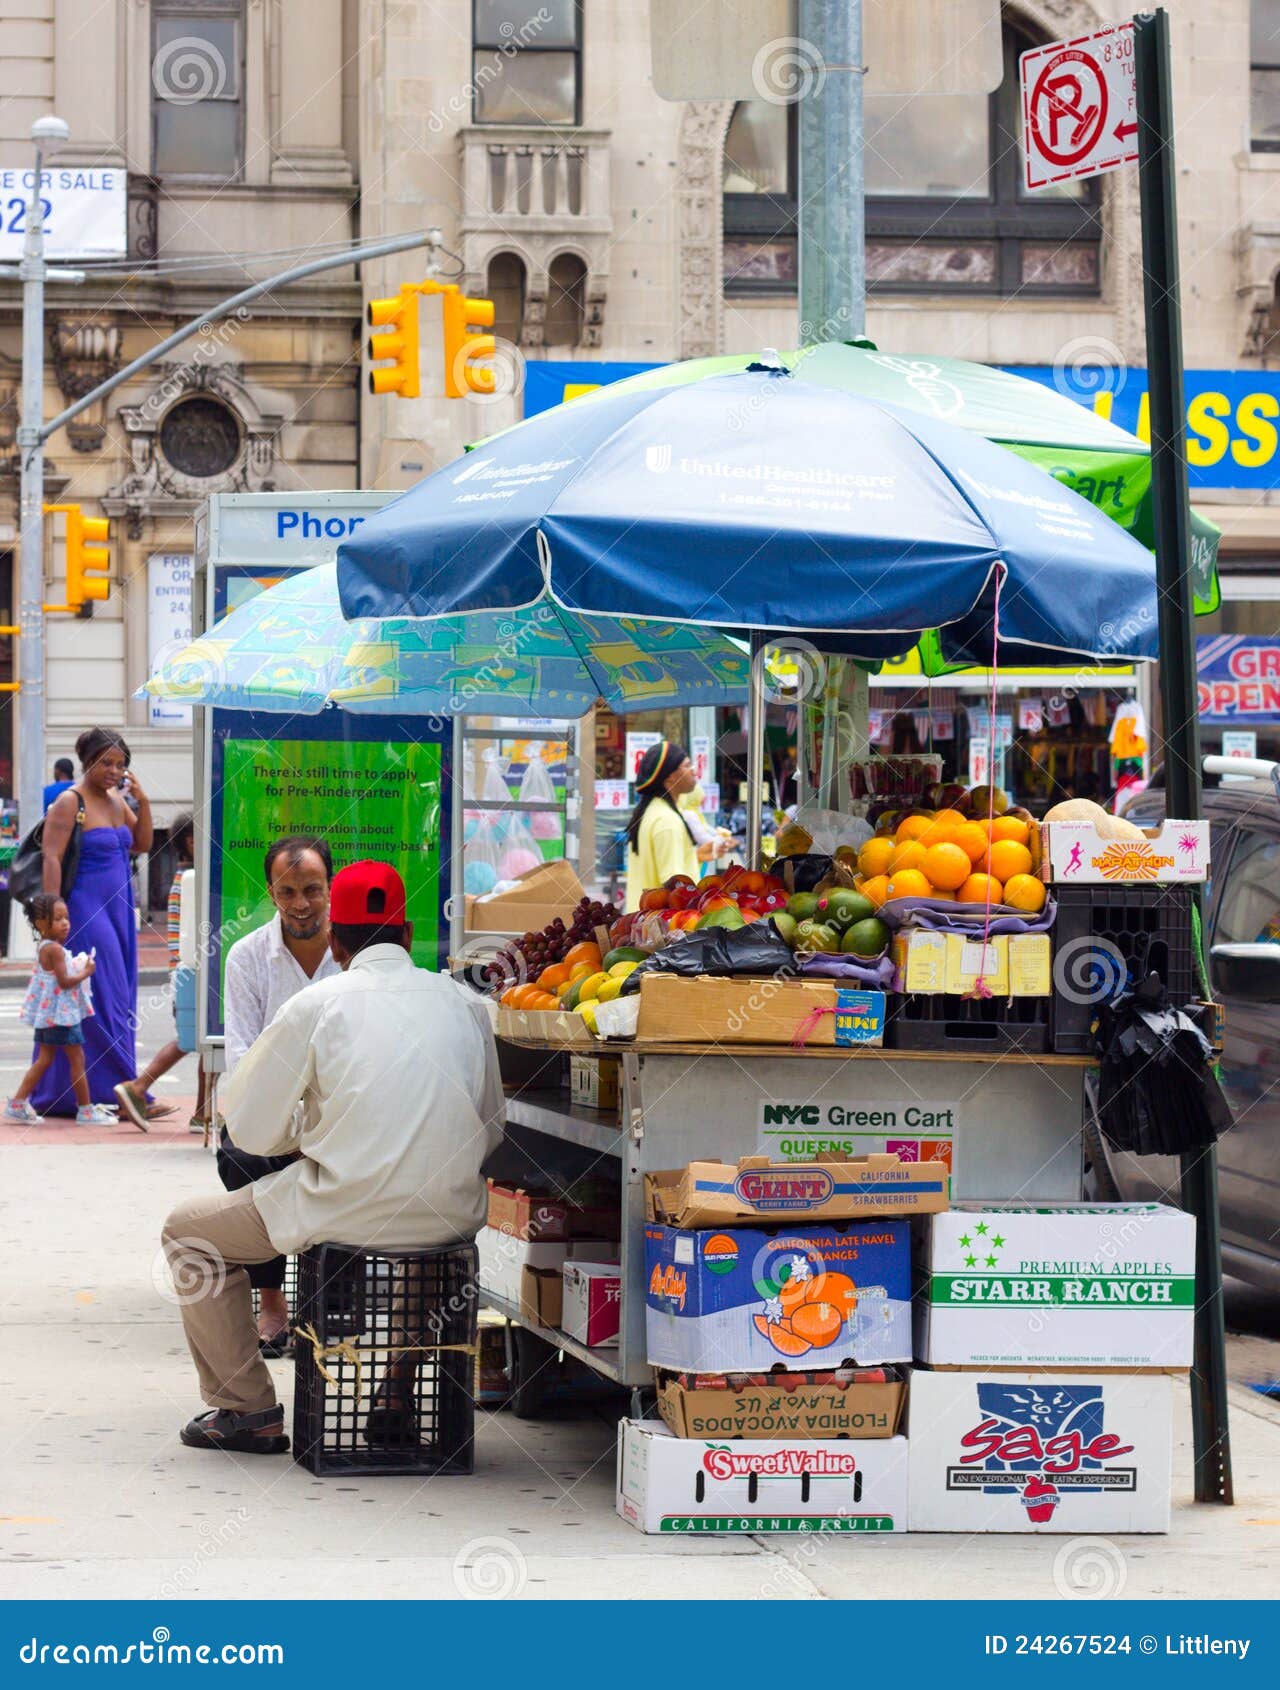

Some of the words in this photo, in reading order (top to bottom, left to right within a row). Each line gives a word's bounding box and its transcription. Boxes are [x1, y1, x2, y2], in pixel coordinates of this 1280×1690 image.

[0, 172, 15, 189] E
[59, 172, 114, 190] SALE
[0, 198, 52, 234] 22
[680, 458, 897, 487] UnitedHealthcare
[163, 556, 190, 568] FOR
[172, 571, 192, 582] OR
[253, 766, 289, 779] There
[293, 766, 303, 779] is
[306, 766, 329, 779] still
[333, 767, 361, 780] time
[365, 768, 378, 780] to
[381, 768, 418, 784] apply
[265, 785, 284, 798] for
[268, 822, 287, 833] For
[290, 822, 357, 834] information
[360, 823, 394, 835] about
[229, 839, 265, 852] public
[1091, 856, 1175, 868] MARATHON
[763, 1105, 820, 1126] NYC
[827, 1106, 897, 1127] Green
[904, 1108, 954, 1128] Cart
[780, 1139, 854, 1155] QUEENS
[861, 1172, 911, 1182] CALIFORNIA
[739, 1174, 827, 1201] GIANT
[853, 1194, 919, 1206] STRAWBERRIES
[767, 1239, 832, 1252] CALIFORNIA
[835, 1236, 860, 1248] LATE
[862, 1233, 896, 1246] NAVEL
[807, 1249, 859, 1263] ORANGES
[1019, 1261, 1104, 1275] PREMIUM
[1111, 1262, 1172, 1276] APPLES
[950, 1279, 1053, 1301] STARR
[1062, 1281, 1173, 1302] RANCH
[692, 1415, 800, 1432] AVOCADOS
[806, 1412, 888, 1428] FLORIDA
[956, 1475, 970, 1484] AN
[970, 1475, 1025, 1484] EXCEPTIONAL
[1053, 1475, 1082, 1484] EATING
[1083, 1475, 1130, 1485] EXPERIENCE
[671, 1519, 806, 1531] CALIFORNIA
[820, 1519, 884, 1531] FRUIT
